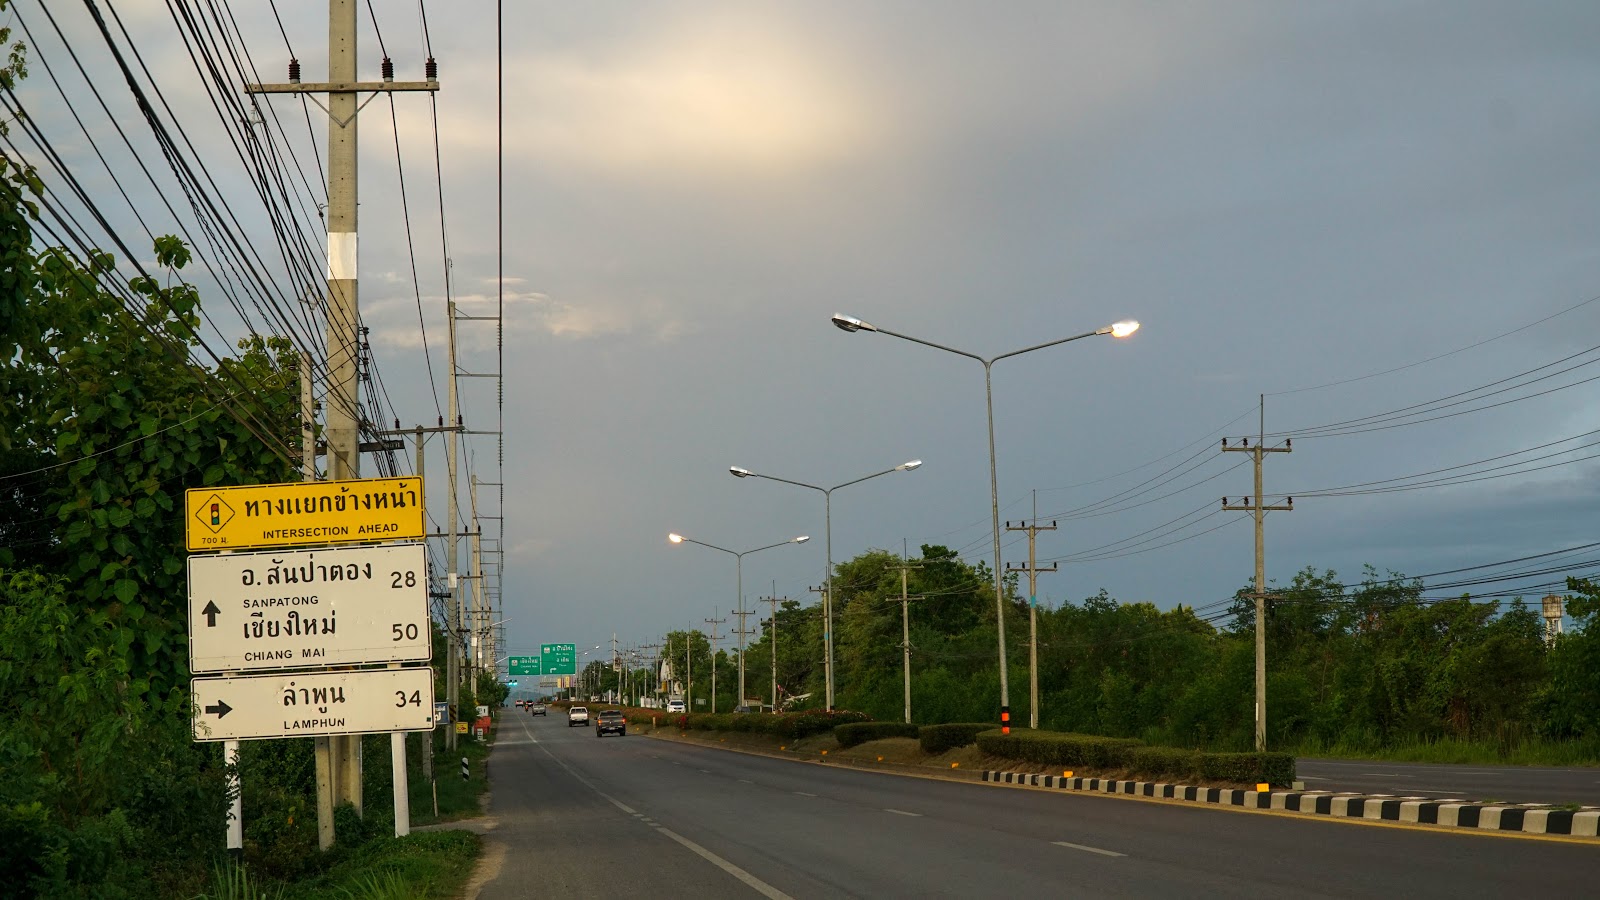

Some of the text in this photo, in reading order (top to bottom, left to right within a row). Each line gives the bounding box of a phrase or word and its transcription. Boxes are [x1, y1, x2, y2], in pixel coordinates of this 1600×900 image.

[245, 482, 416, 517] ทางแยกข้างหน้า
[263, 523, 399, 539] INTERSECTION AHEAD
[391, 571, 417, 589] 28
[243, 595, 319, 609] SANPATONG
[243, 610, 419, 642] เชียงใหม่ 50
[244, 647, 326, 662] CHIANG MAI
[283, 681, 422, 714] ลำพูน 34
[283, 717, 345, 730] LAMPHUN
